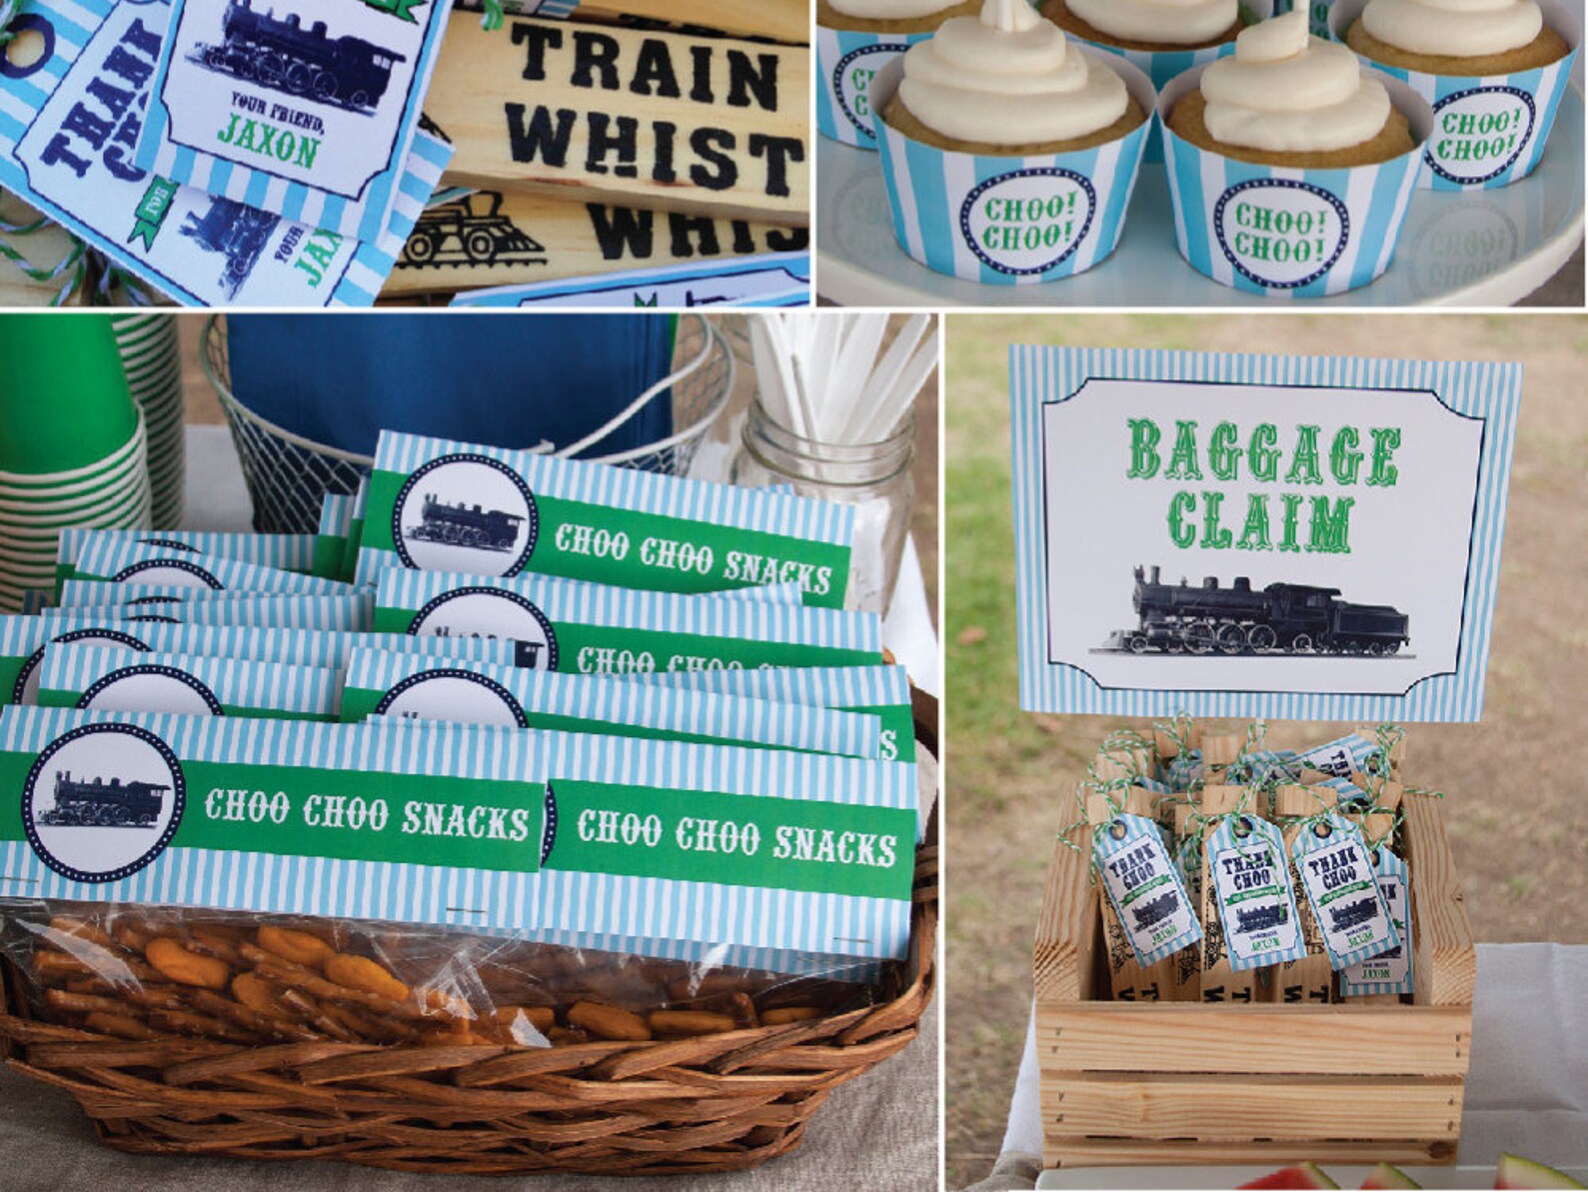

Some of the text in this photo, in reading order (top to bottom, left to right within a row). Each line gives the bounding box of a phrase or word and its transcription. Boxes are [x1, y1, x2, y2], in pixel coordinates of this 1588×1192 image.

[511, 22, 779, 112] TRAIN
[232, 91, 268, 116] YOUR
[1441, 107, 1523, 135] CHOO!
[217, 113, 321, 170] JAXON
[504, 102, 804, 197] WHIST
[1437, 132, 1517, 161] CHOO!
[146, 186, 170, 216] FOR
[984, 191, 1078, 222] CHOO!
[1235, 202, 1328, 235] CHOO!
[274, 225, 305, 264] YOUR
[982, 220, 1074, 250] CHOO!
[1234, 231, 1324, 263] CHOO!
[1126, 417, 1401, 487] BAGGAGE
[1166, 491, 1356, 554] CLAIM
[555, 523, 833, 595] CHOO CHOO SNACKS
[577, 646, 656, 674] CHOO
[204, 788, 530, 842] CHOO CHOO SNACKS
[577, 809, 898, 868] CHOO CHOO SNACKS
[1109, 842, 1156, 878] THANK
[1122, 862, 1155, 890] CHOO
[1308, 846, 1359, 877] THANK
[1233, 869, 1271, 891] CHOO
[1322, 865, 1357, 890] CHOO
